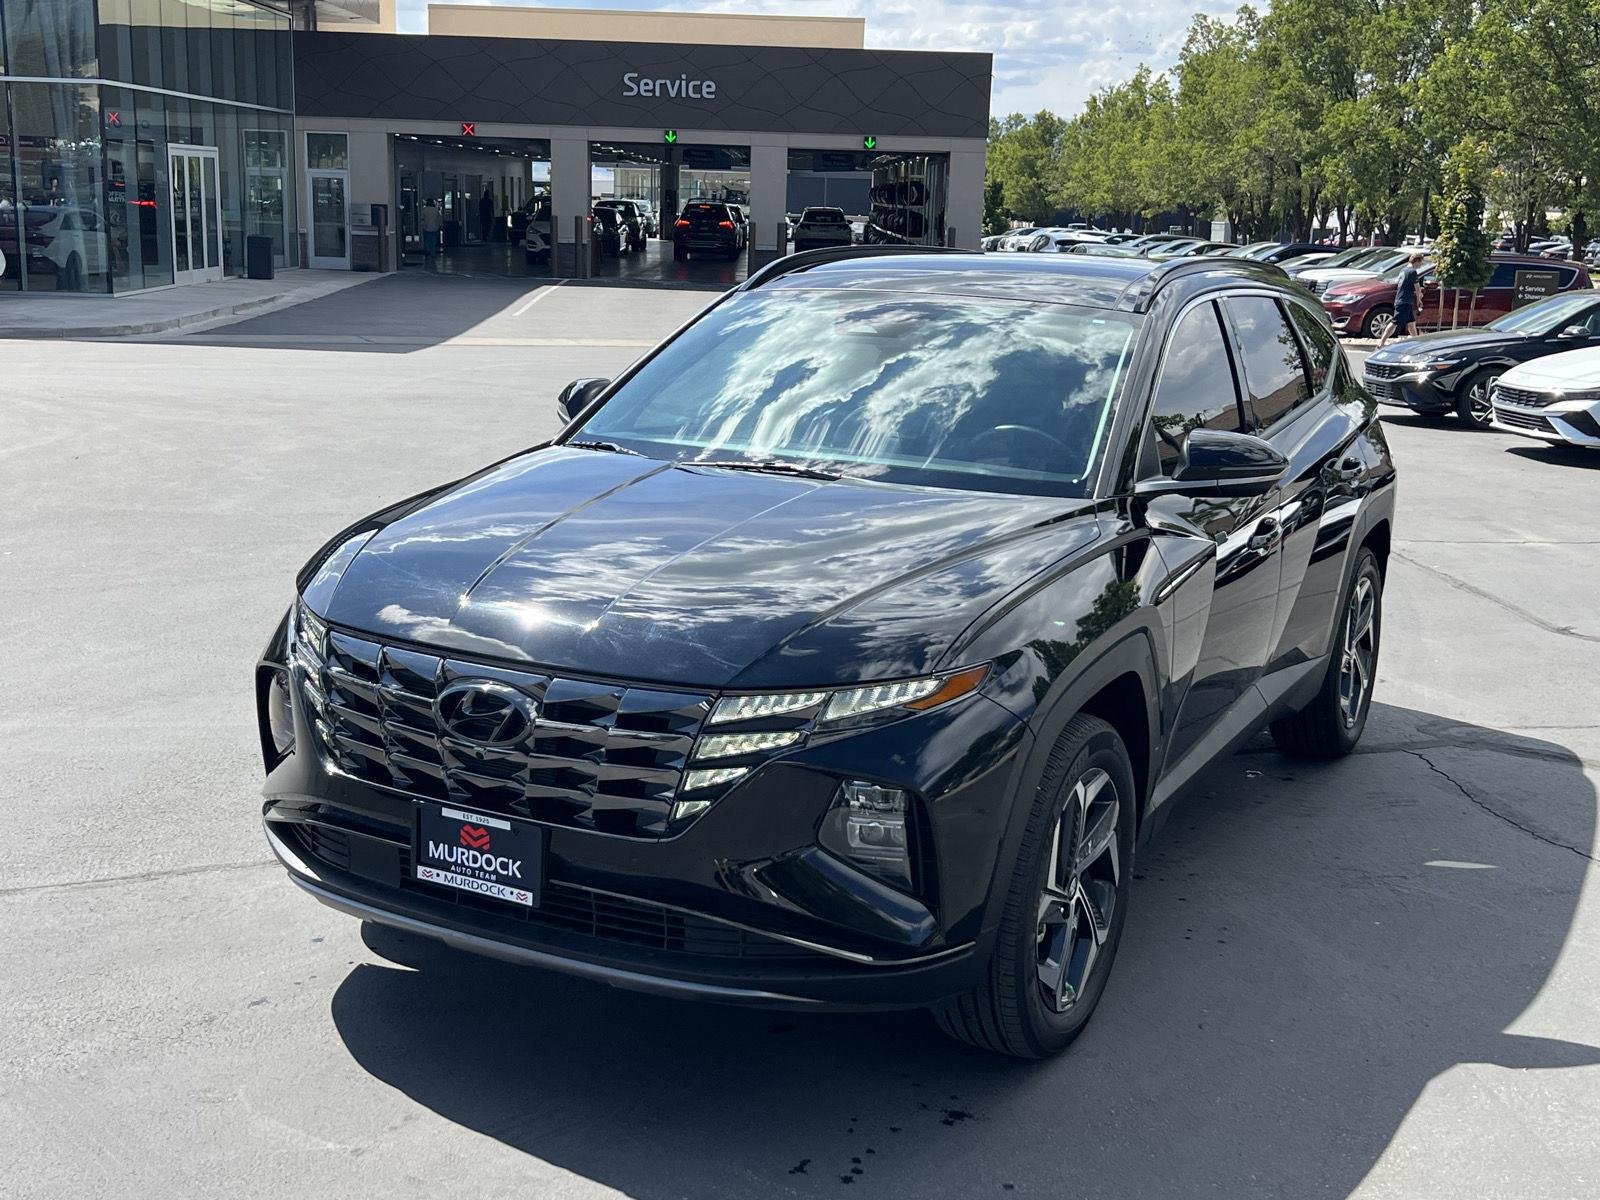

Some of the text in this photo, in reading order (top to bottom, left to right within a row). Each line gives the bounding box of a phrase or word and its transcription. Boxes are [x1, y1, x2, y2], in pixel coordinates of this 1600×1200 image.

[622, 72, 717, 99] Service
[1525, 285, 1546, 293] Service
[475, 815, 490, 825] 1925
[428, 840, 522, 879] MURDOCK
[450, 864, 497, 882] AUTO TEAM
[443, 873, 507, 898] MURDOCK
